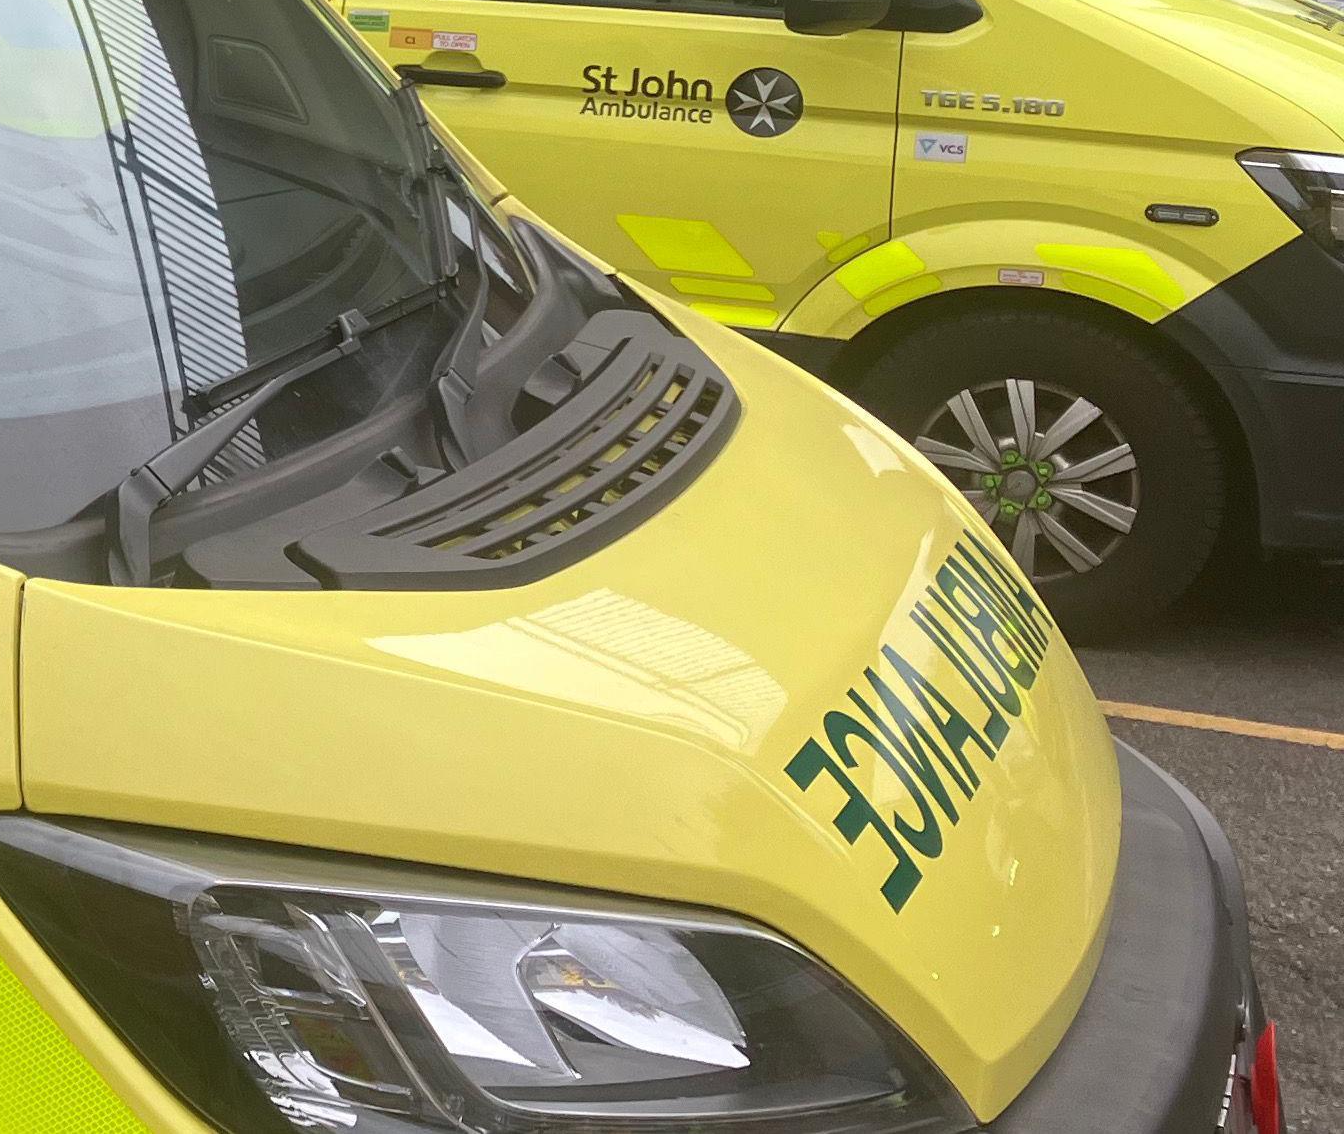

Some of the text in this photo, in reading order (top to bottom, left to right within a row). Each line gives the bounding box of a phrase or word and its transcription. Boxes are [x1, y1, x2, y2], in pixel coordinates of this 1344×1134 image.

[581, 64, 713, 102] St John
[579, 96, 713, 124] Ambulance
[920, 89, 1066, 117] TGE 5.180
[939, 143, 965, 155] VCS
